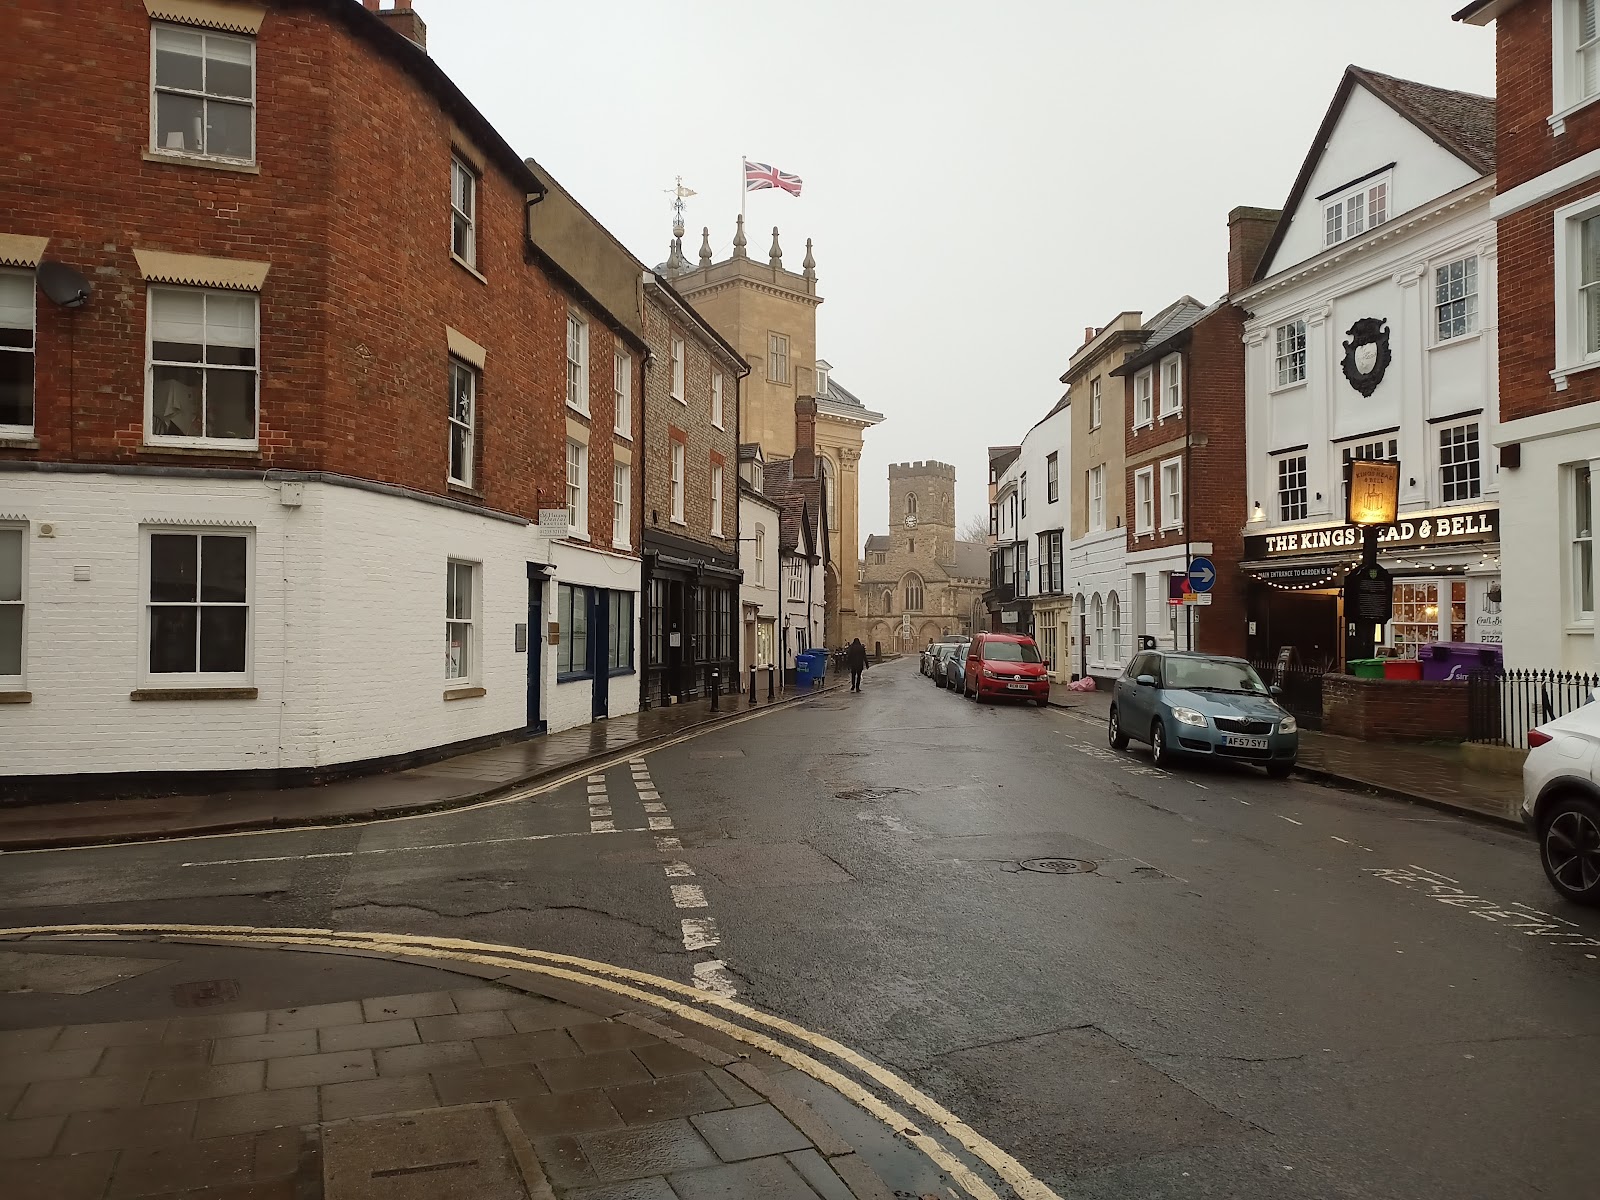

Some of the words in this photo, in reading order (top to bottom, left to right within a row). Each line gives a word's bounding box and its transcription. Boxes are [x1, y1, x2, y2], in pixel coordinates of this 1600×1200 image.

[1266, 534, 1298, 552] THE
[1300, 528, 1355, 549] KINGS
[1359, 522, 1415, 544] EAD
[1419, 520, 1432, 538] &
[1436, 514, 1493, 537] BELL
[1270, 570, 1293, 578] ENTRANCE
[1301, 568, 1320, 576] GARDEN
[1321, 567, 1326, 575] &
[1228, 738, 1250, 747] AF57
[1251, 740, 1267, 748] SYT
